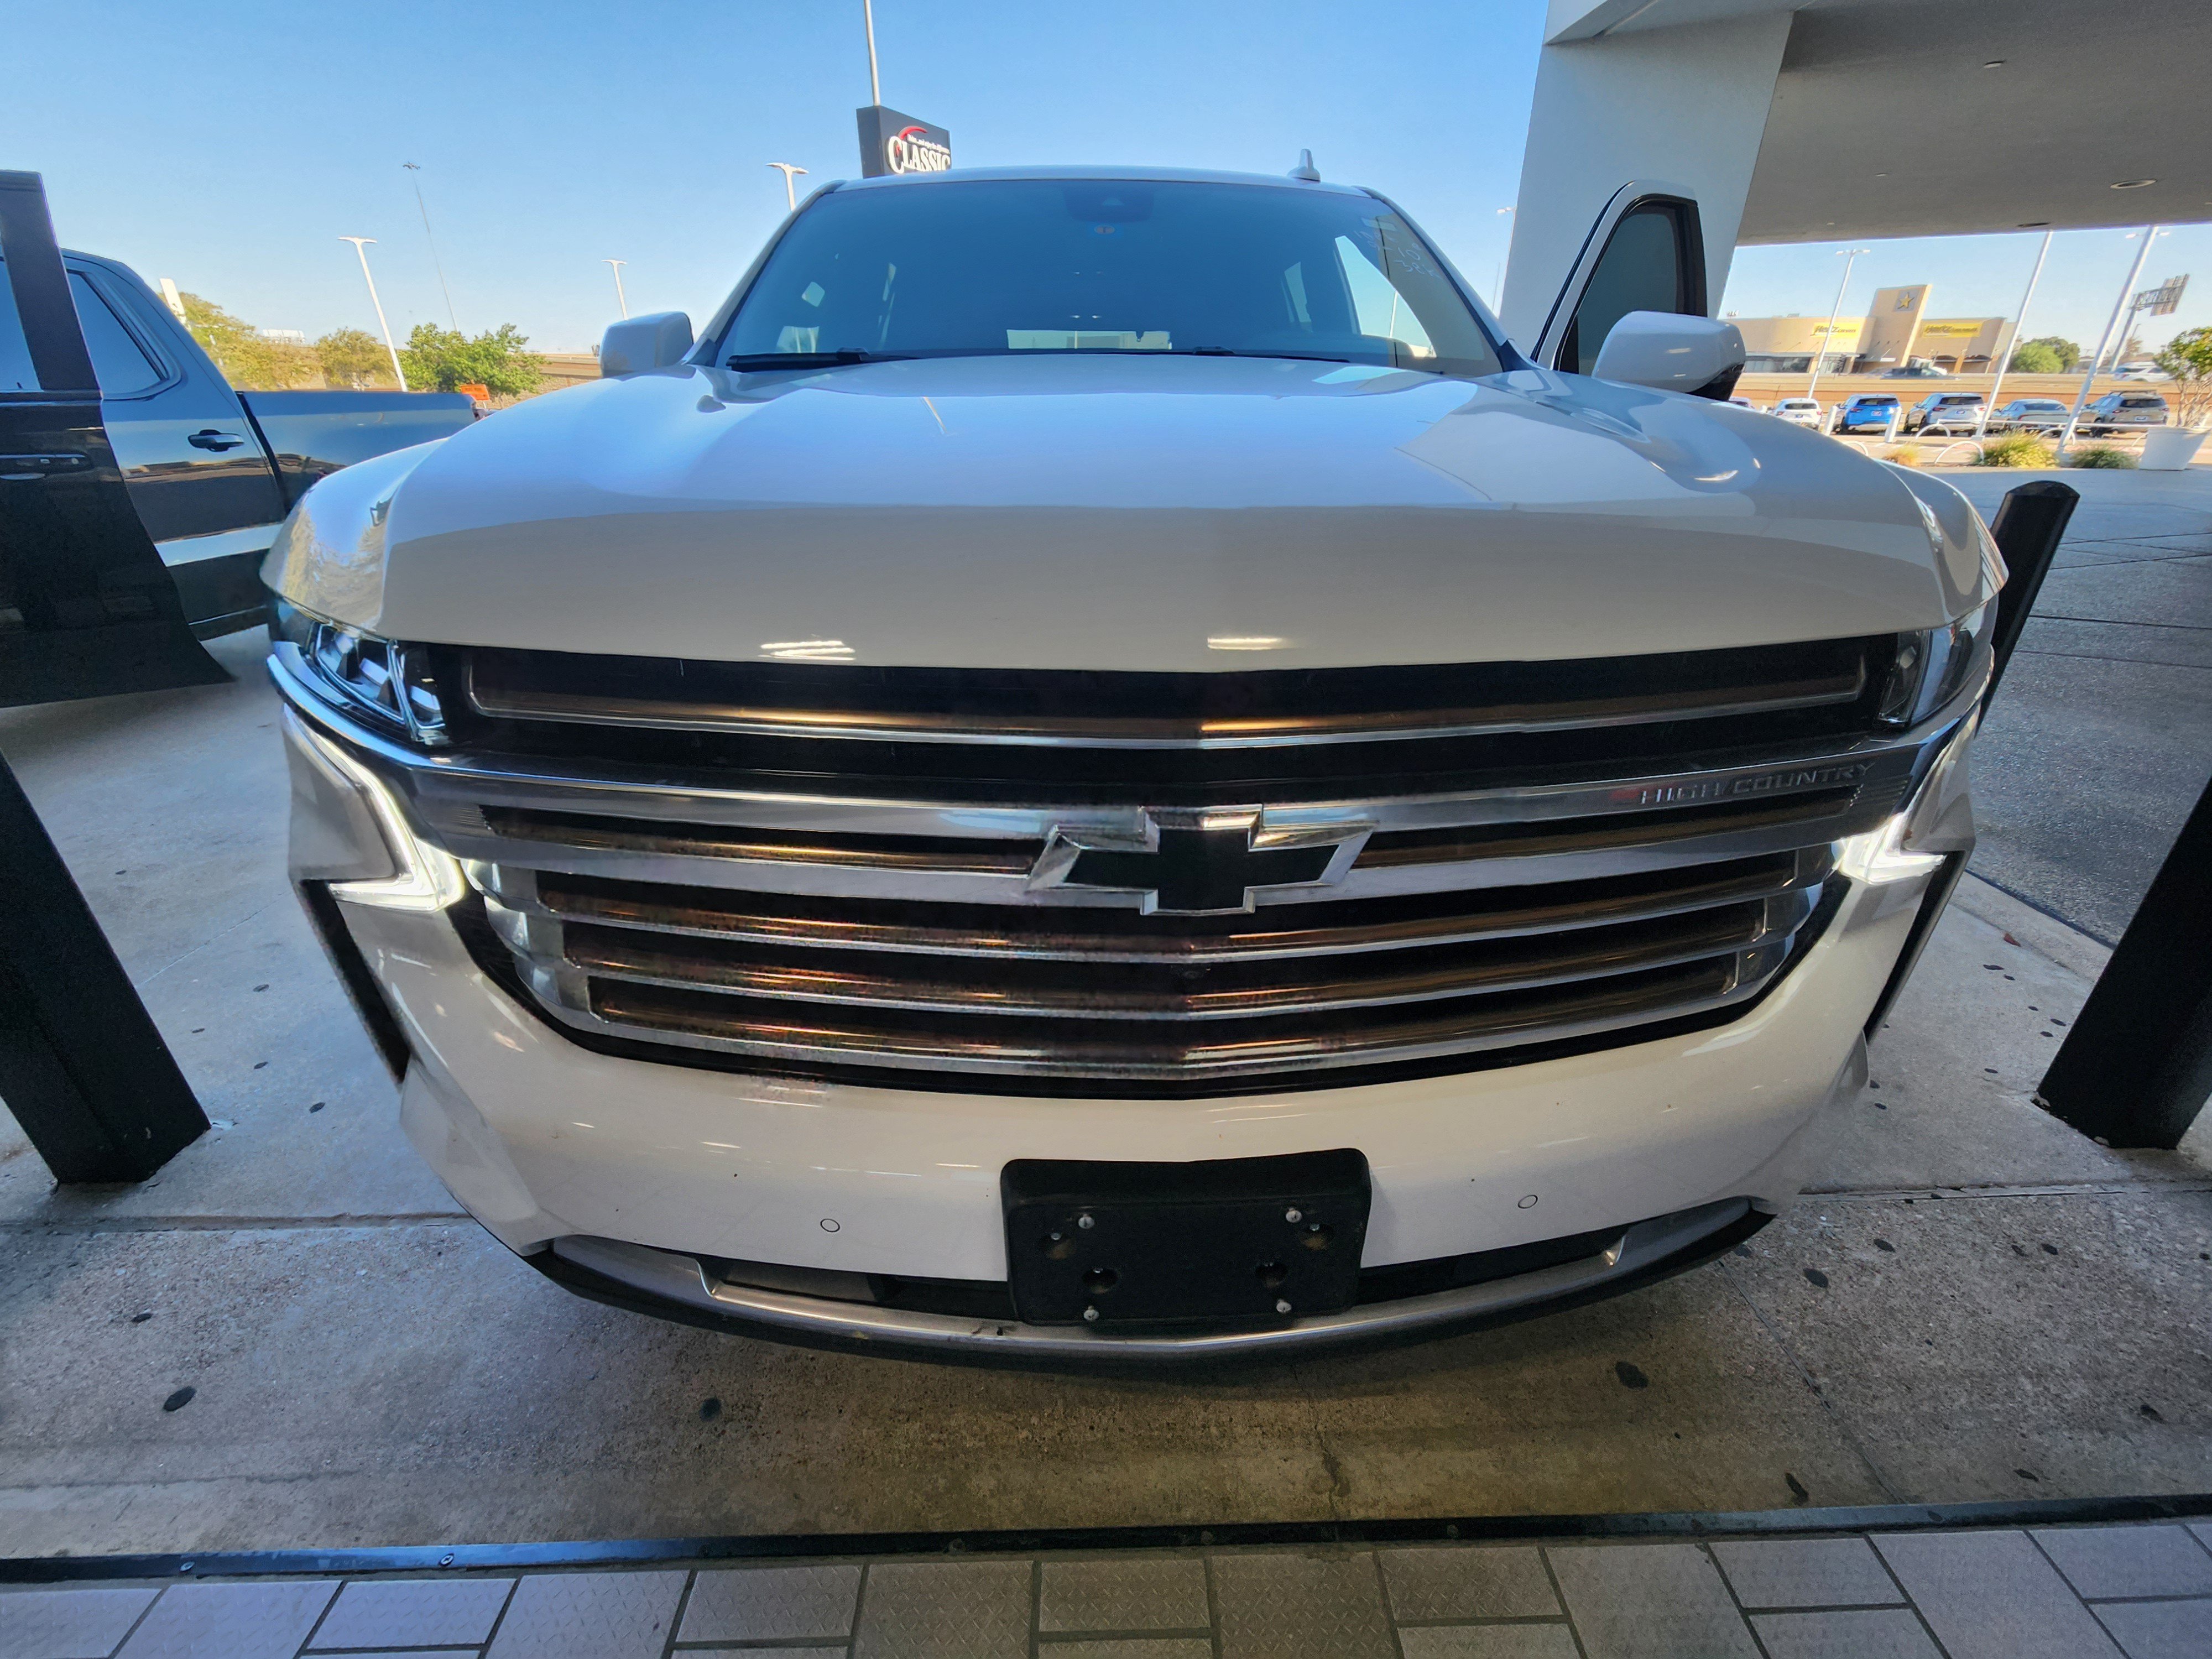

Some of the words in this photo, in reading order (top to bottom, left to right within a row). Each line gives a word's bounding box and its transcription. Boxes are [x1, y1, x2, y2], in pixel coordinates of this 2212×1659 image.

[888, 135, 951, 174] CLASSIC
[1640, 781, 1720, 806] HIGH
[1733, 761, 1876, 795] COUNTRY
